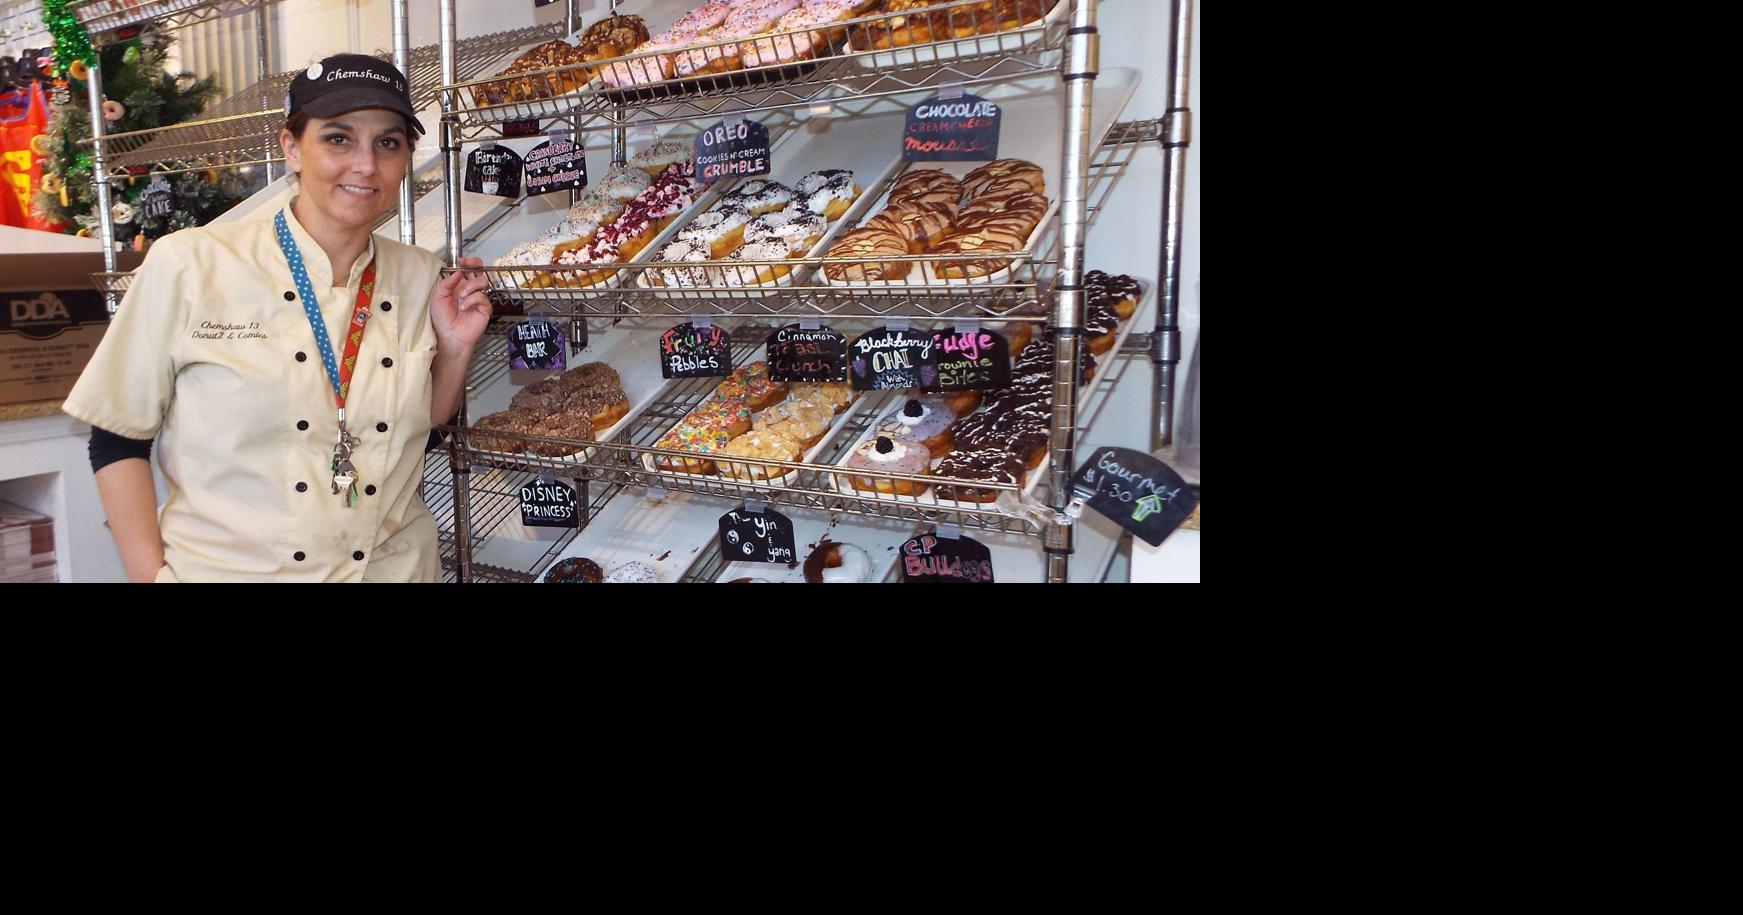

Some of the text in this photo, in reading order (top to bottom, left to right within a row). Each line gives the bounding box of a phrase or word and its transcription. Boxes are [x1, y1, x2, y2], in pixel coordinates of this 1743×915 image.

[326, 68, 391, 82] Chemshaw
[914, 101, 996, 119] CHOCOLATE
[703, 124, 748, 146] OREO
[697, 152, 728, 164] COOKIES
[738, 148, 765, 158] CREAM
[703, 158, 765, 177] CRUMBLE
[517, 322, 550, 340] HEATH
[777, 330, 837, 342] Cinnamon
[525, 341, 548, 358] BAR
[855, 331, 933, 359] Blackberry
[670, 355, 719, 373] Pebbles
[776, 359, 832, 373] Cunch
[872, 349, 913, 373] CHAI
[938, 357, 993, 370] rownie
[1098, 451, 1181, 503] Gourmet
[521, 486, 571, 502] DISNEY
[526, 504, 571, 518] PRINCESS
[904, 536, 937, 556] CP
